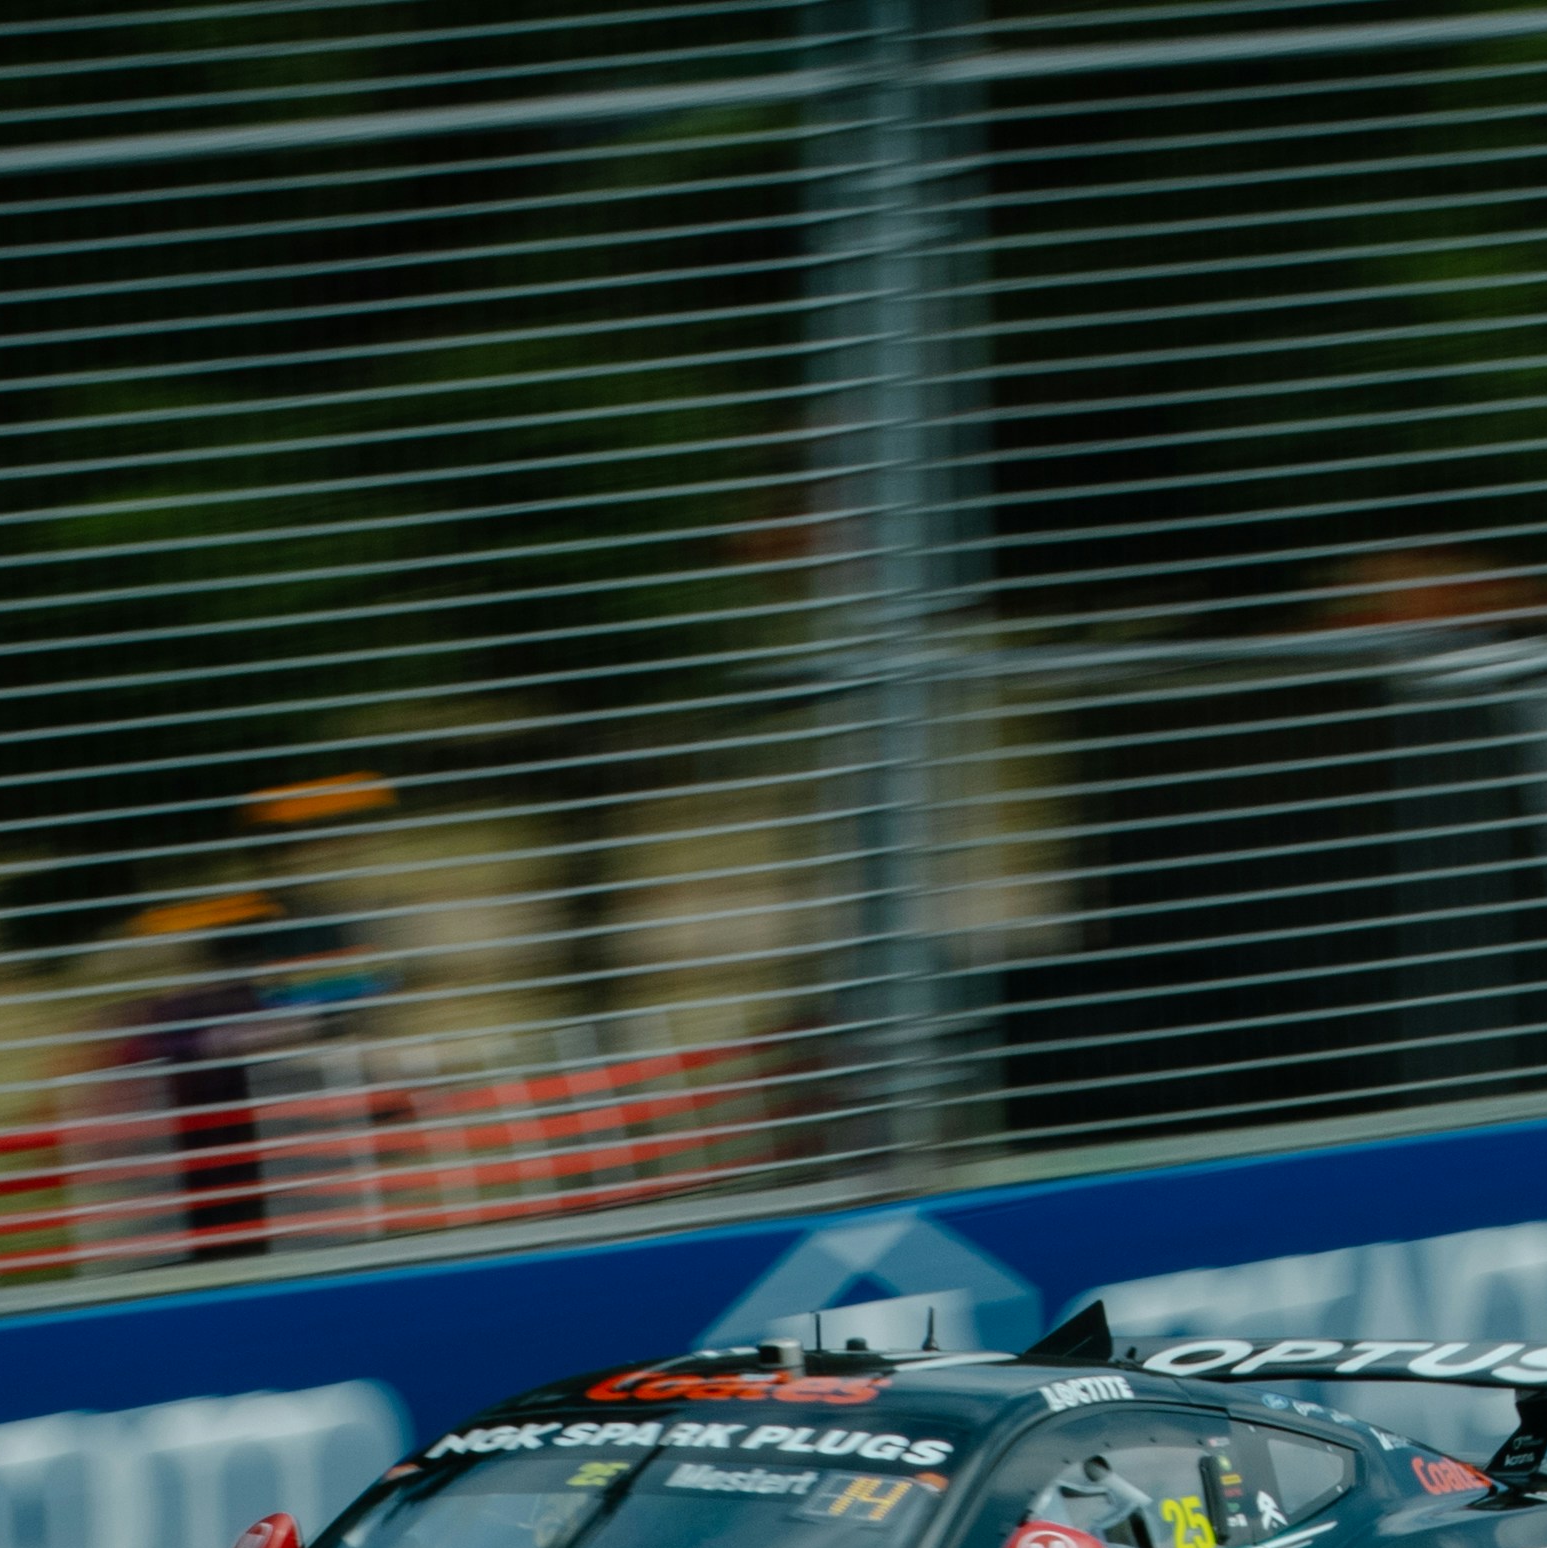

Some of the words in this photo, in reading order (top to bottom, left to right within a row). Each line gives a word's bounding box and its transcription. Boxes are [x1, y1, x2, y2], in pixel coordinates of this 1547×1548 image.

[1039, 1375, 1135, 1412] LOCTITE
[425, 1423, 562, 1461] NGK
[551, 1421, 748, 1450] SPARK
[738, 1424, 955, 1467] PLUGS
[663, 1463, 819, 1495] Mostert
